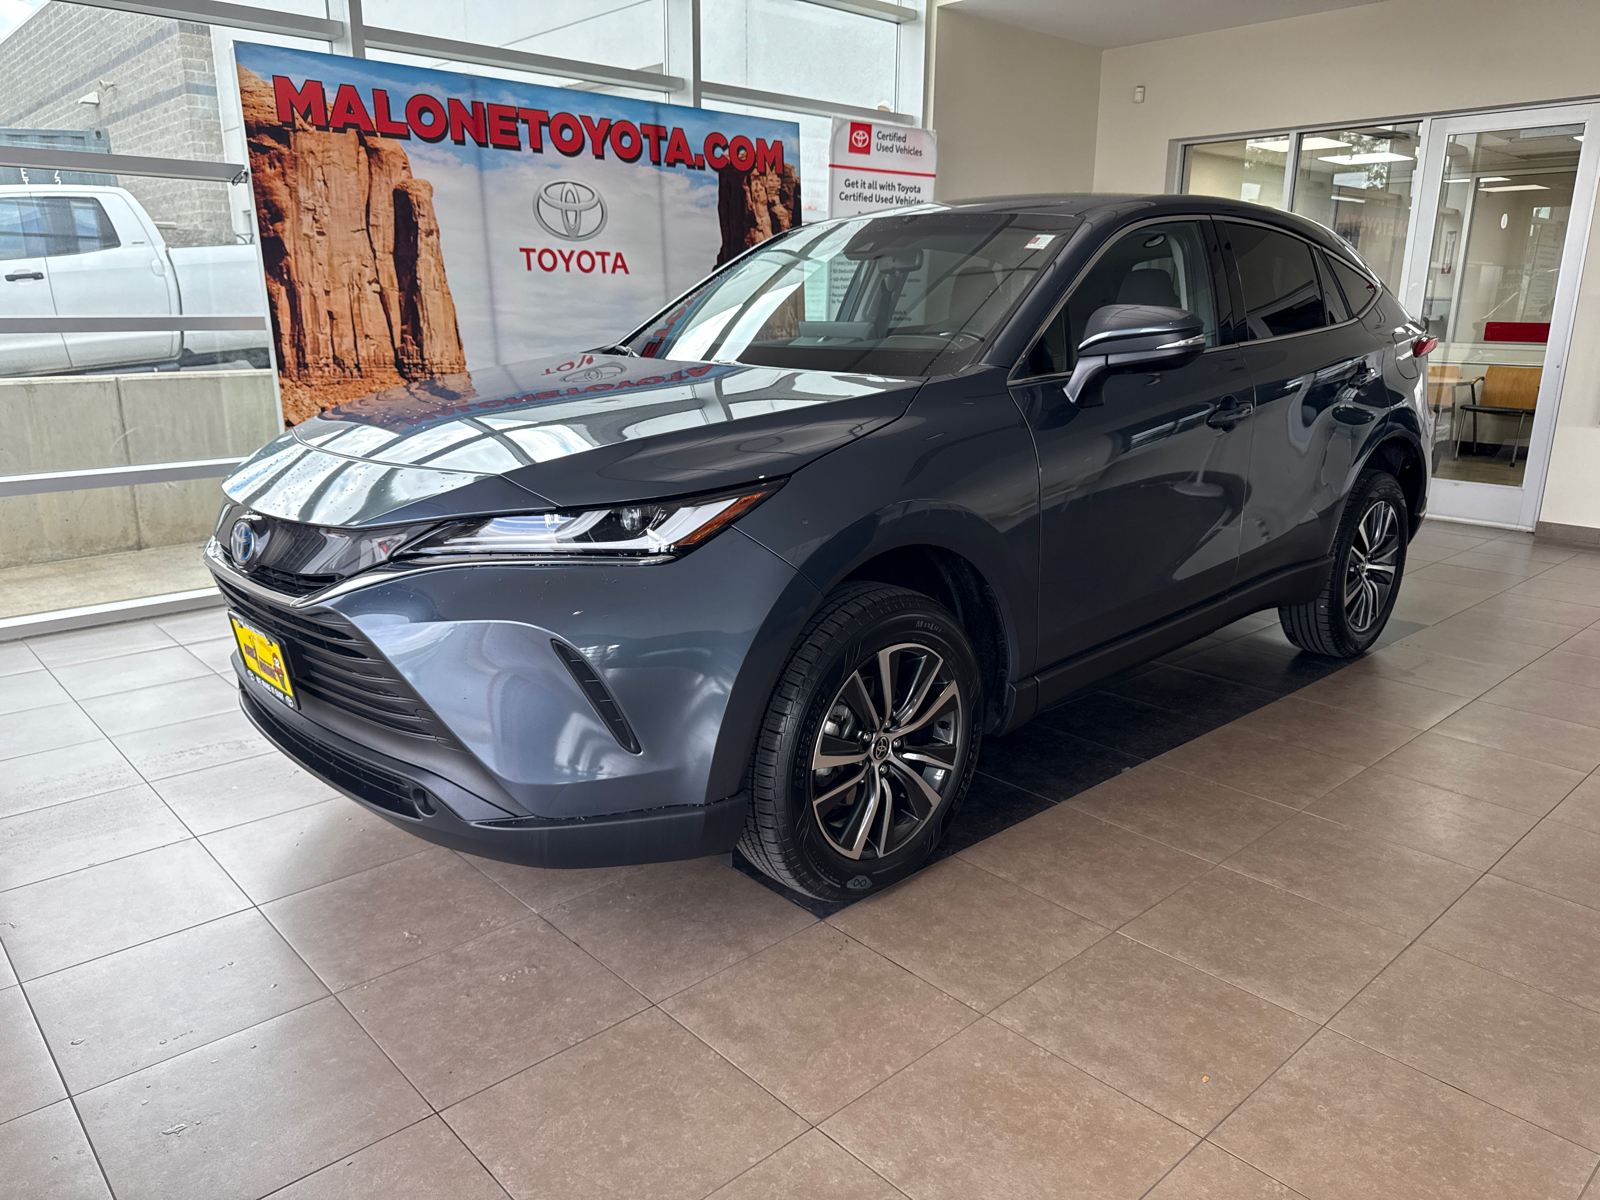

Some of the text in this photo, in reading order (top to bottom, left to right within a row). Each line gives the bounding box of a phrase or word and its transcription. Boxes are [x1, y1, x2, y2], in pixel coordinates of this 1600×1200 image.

[272, 75, 785, 175] MALONETOYOTA.COM
[876, 131, 907, 143] Certified
[876, 143, 922, 157] Used Vehicles
[844, 179, 921, 195] Get it all with Toyota
[839, 191, 874, 203] Certified
[874, 194, 894, 204] Used
[519, 247, 630, 275] TOYOTA
